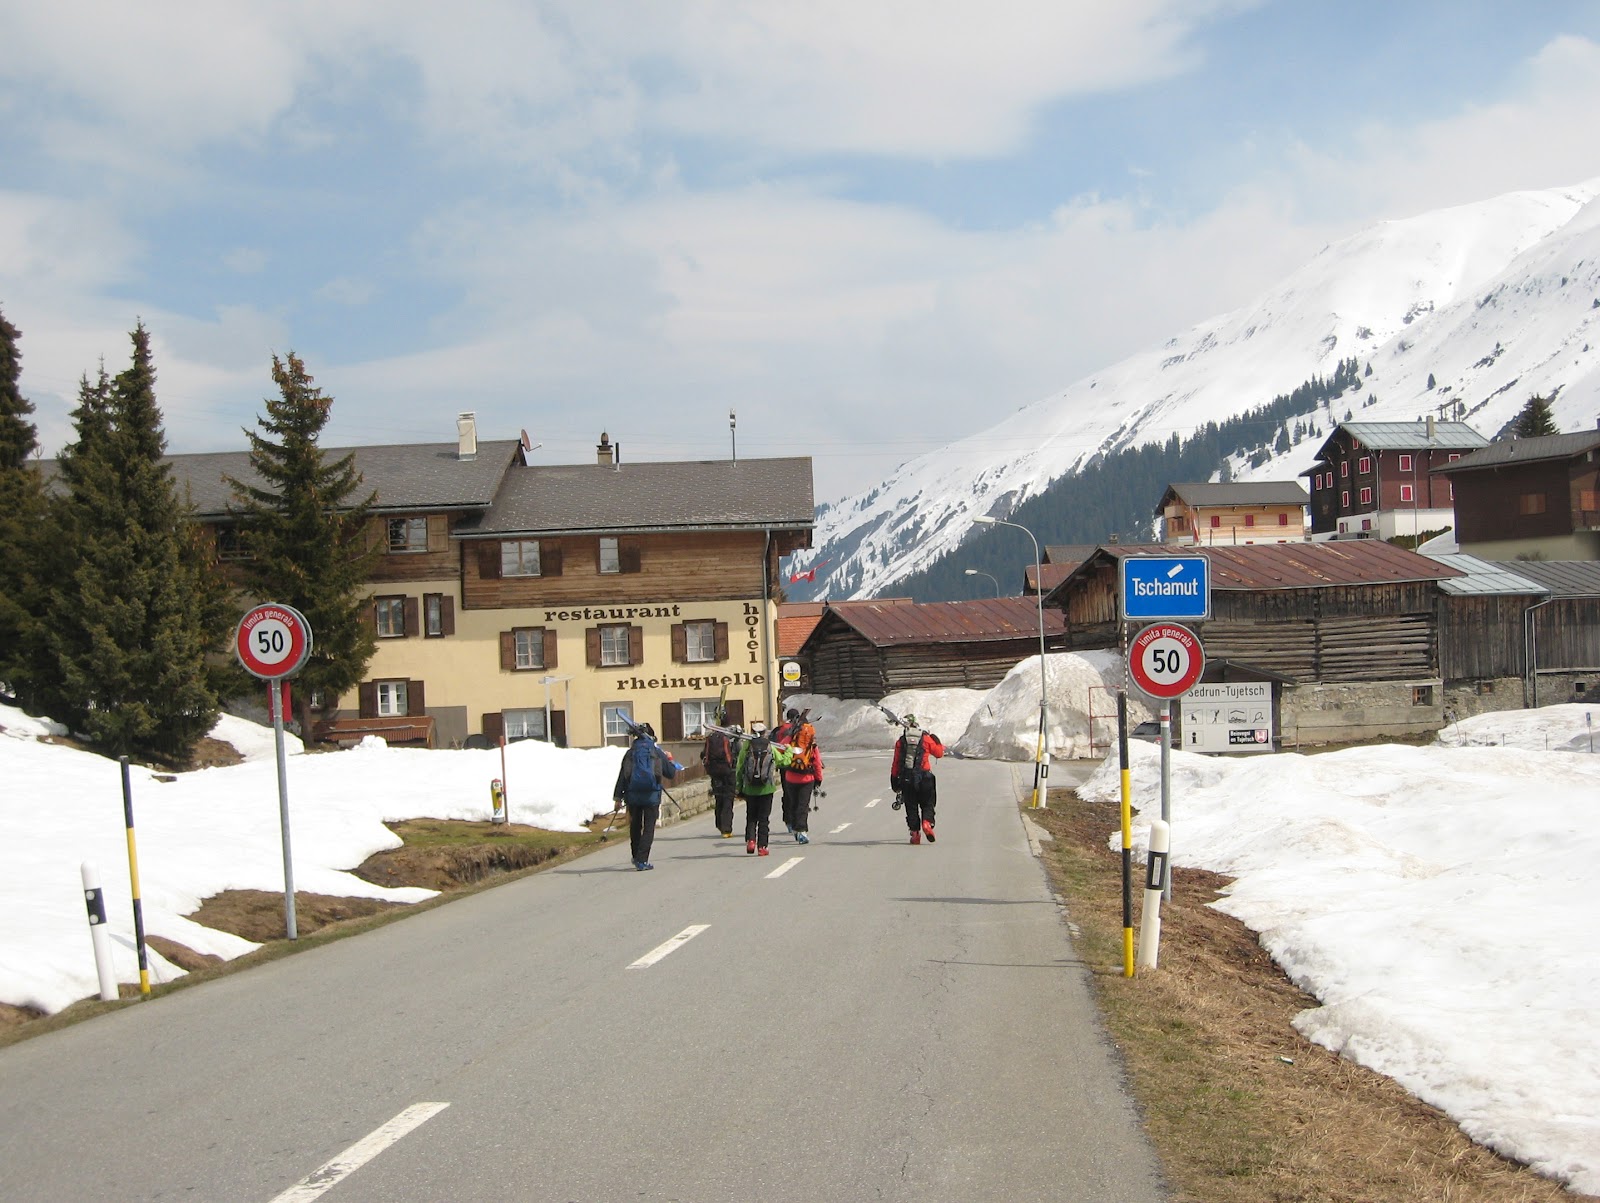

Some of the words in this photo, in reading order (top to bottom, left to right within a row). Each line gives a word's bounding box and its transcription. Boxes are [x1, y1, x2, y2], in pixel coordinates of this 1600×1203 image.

[1132, 578, 1198, 596] Tschamut
[243, 612, 264, 630] limita
[264, 610, 294, 627] generala
[544, 604, 681, 622] restaurant
[258, 630, 284, 654] 50
[743, 603, 760, 663] hotel
[1138, 629, 1160, 647] limita
[1162, 628, 1193, 648] generala
[1153, 649, 1180, 674] 50
[616, 672, 765, 690] rheinquelle
